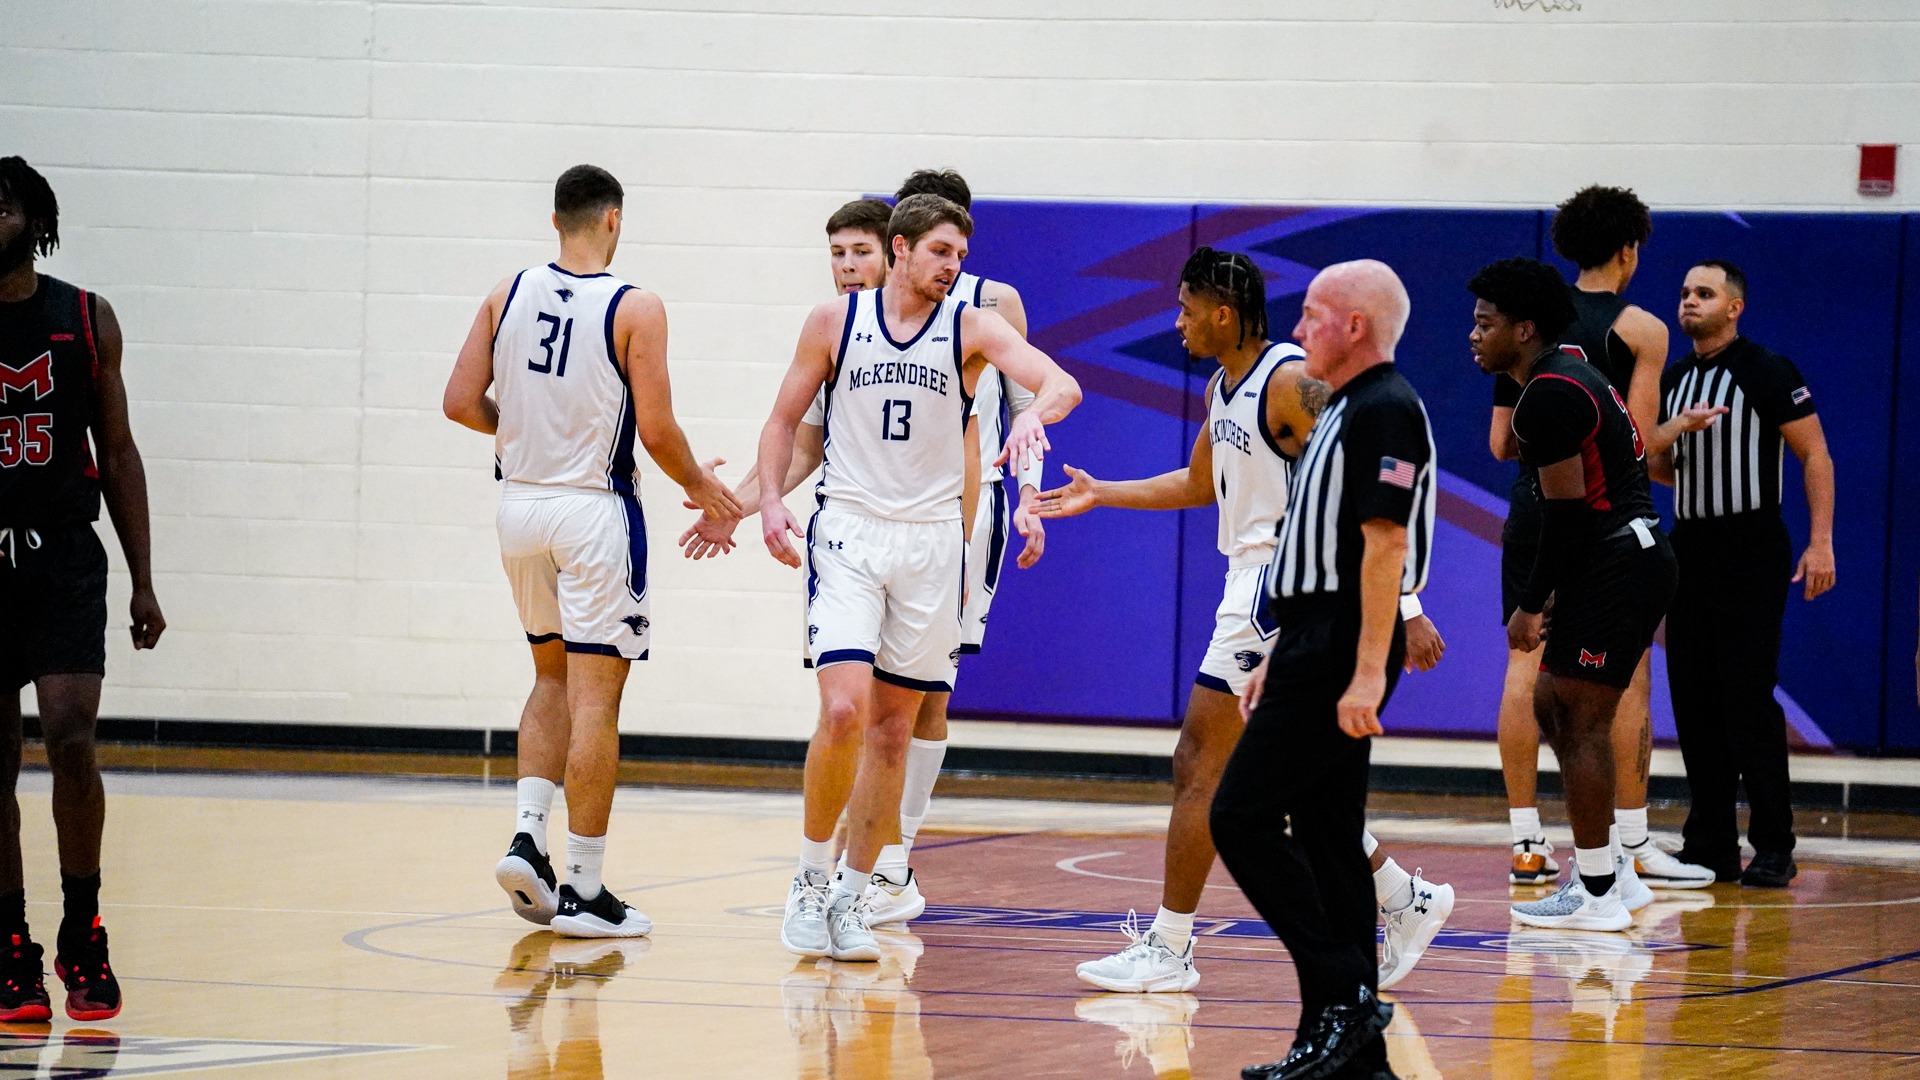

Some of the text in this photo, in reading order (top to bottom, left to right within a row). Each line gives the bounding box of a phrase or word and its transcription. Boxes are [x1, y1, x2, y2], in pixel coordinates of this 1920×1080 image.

[528, 311, 573, 377] 31
[849, 362, 948, 397] McKENDREE
[0, 413, 53, 467] 35
[882, 399, 912, 441] 13
